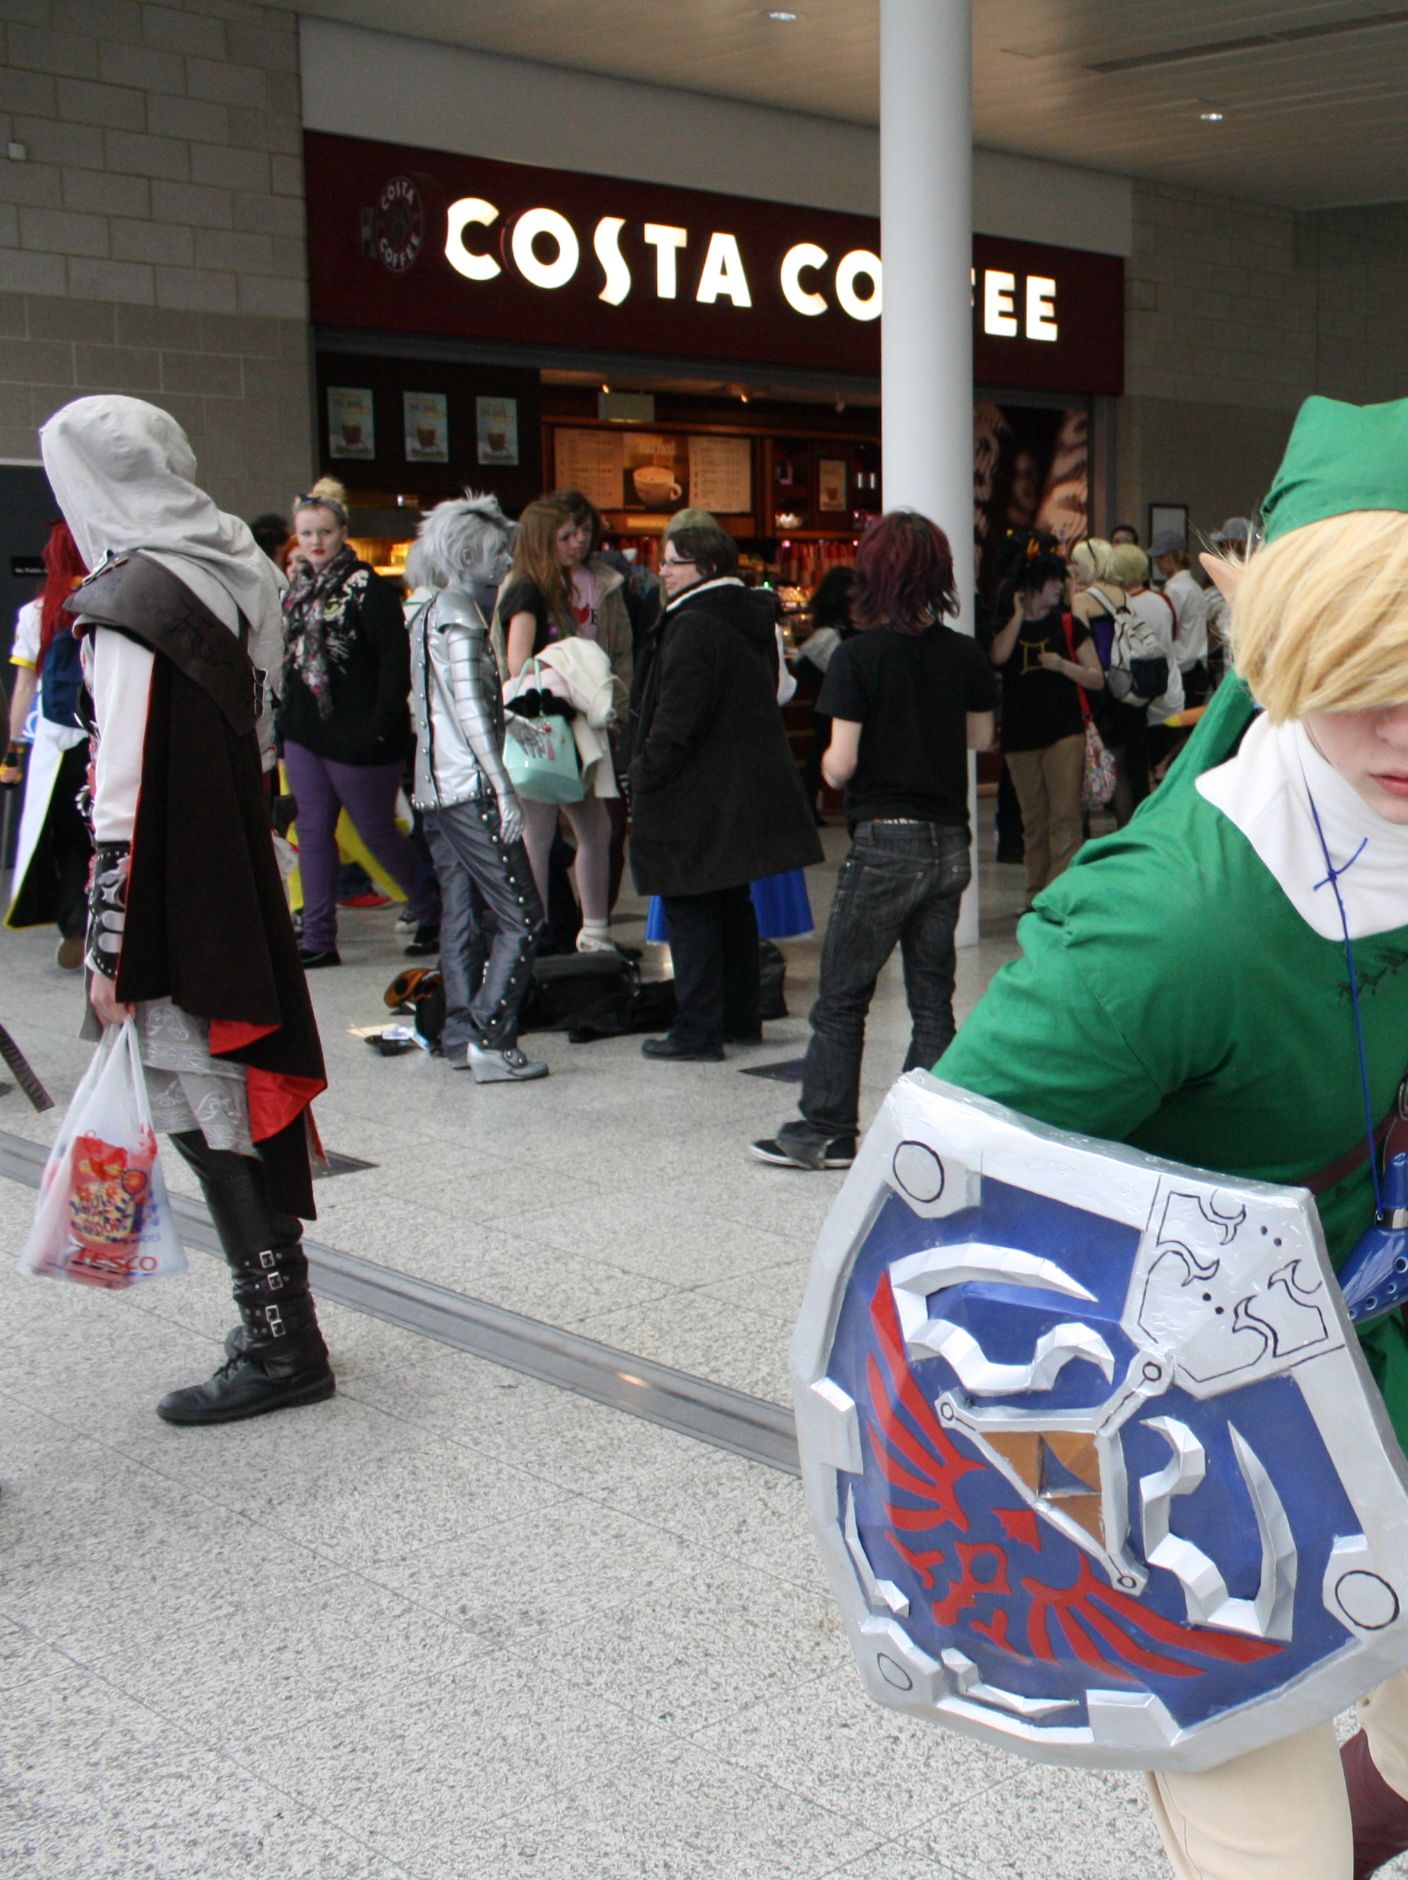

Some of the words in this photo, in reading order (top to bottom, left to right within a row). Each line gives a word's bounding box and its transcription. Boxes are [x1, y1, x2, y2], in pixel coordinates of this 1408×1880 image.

[381, 181, 415, 210] COSTA
[445, 197, 752, 306] COSTA
[780, 243, 1058, 342] COEE
